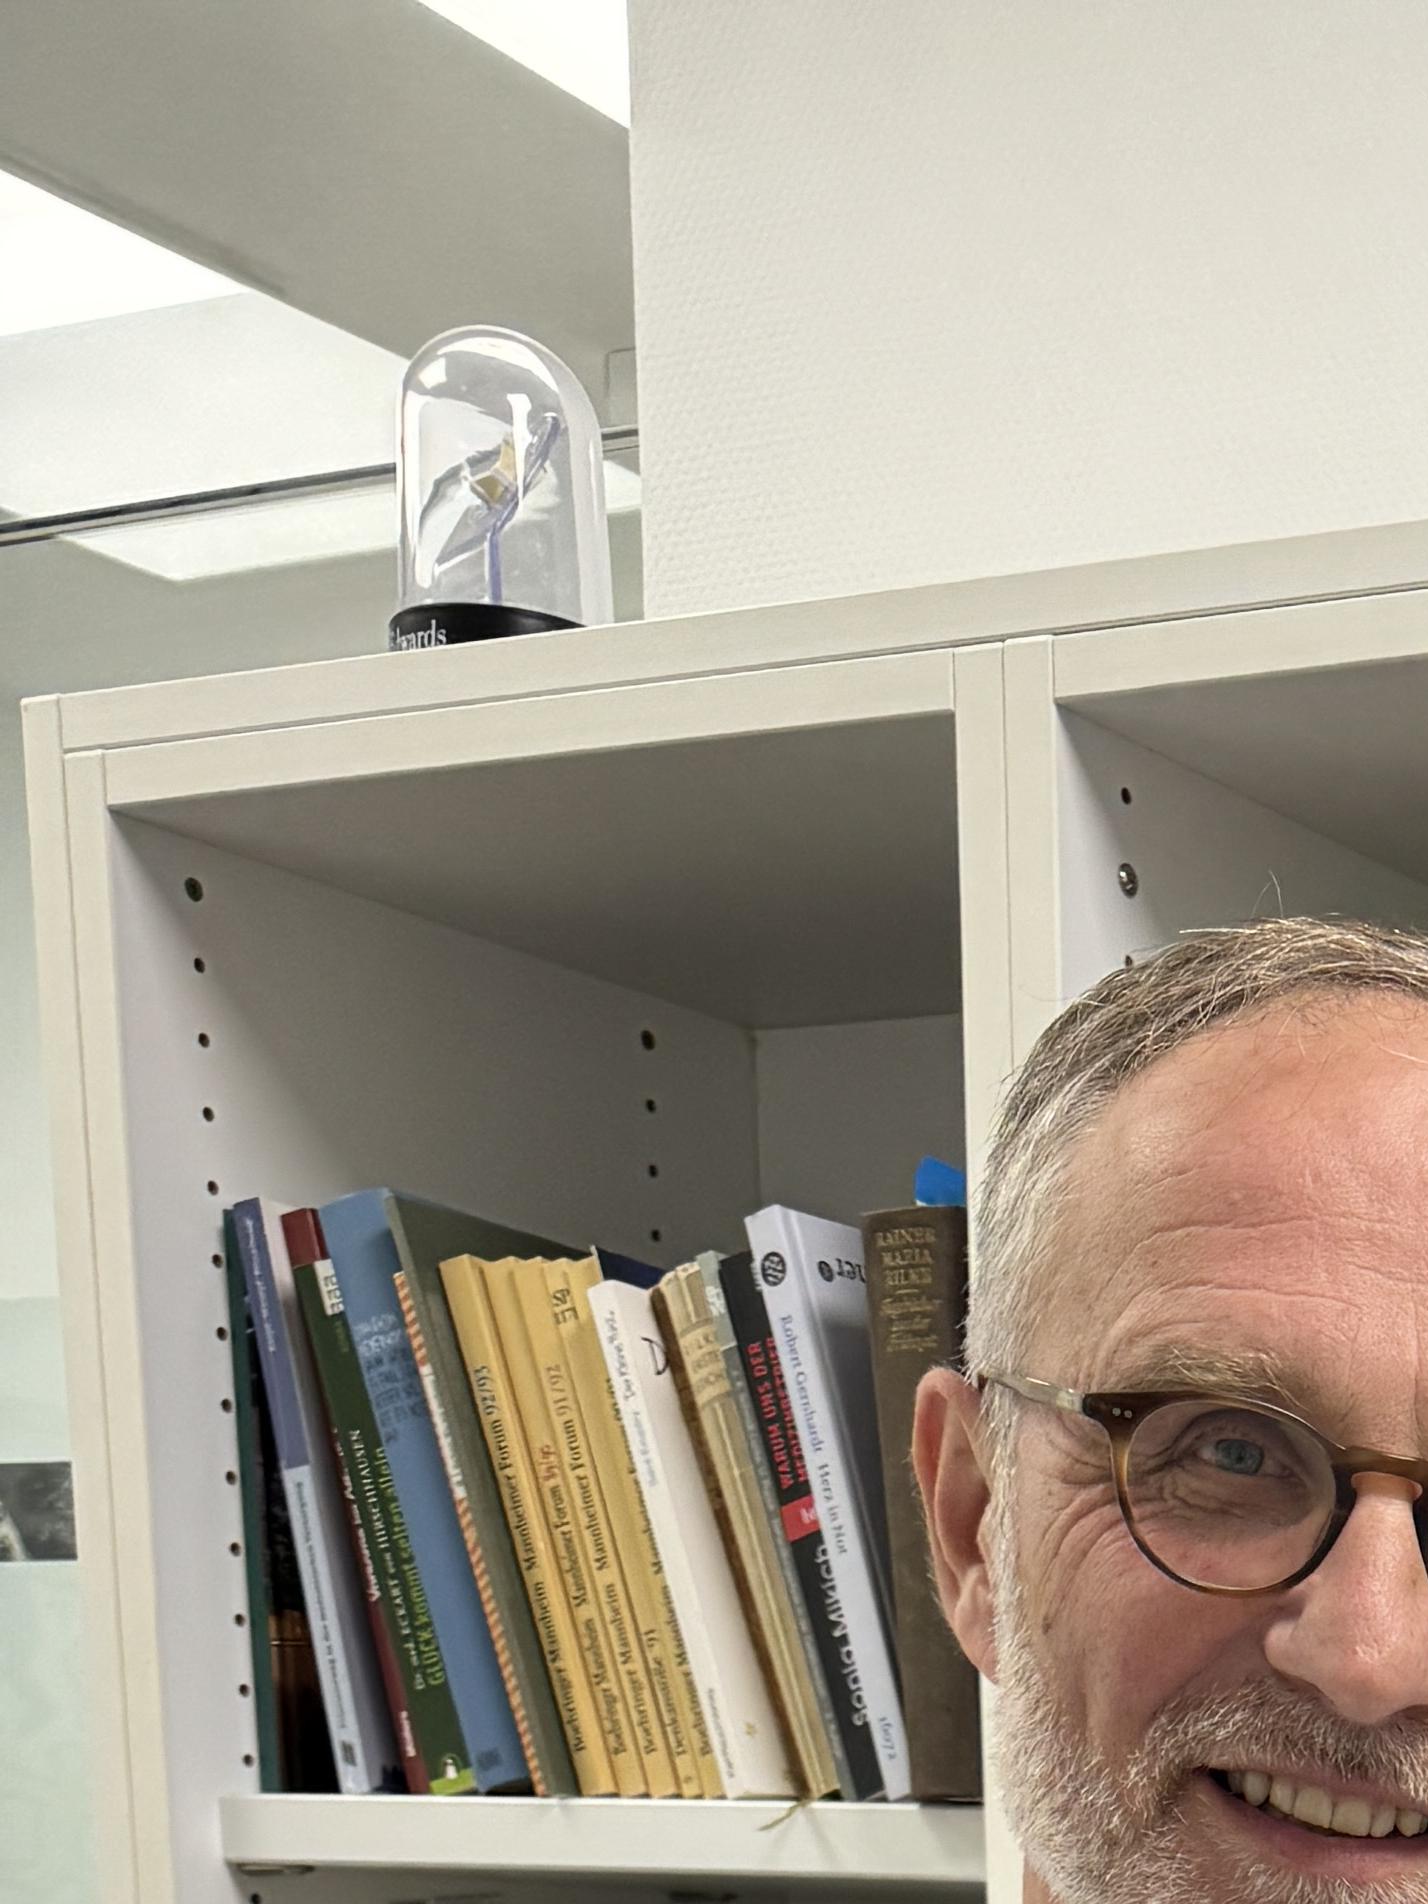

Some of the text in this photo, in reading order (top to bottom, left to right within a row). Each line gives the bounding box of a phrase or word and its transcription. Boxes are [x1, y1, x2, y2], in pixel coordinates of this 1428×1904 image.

[876, 1228, 936, 1246] RAINER
[881, 1249, 933, 1266] MARIA
[747, 1341, 793, 1488] WARUM UNS DER
[780, 1314, 847, 1554] Robert Gernhardt Herz in Not
[374, 1445, 397, 1496] allein
[384, 1503, 412, 1560] selten
[545, 1363, 656, 1754] Boehringer Mannheim Mannheimer Forum 91/92
[402, 1561, 429, 1625] kommt
[417, 1626, 445, 1685] GLÜCK
